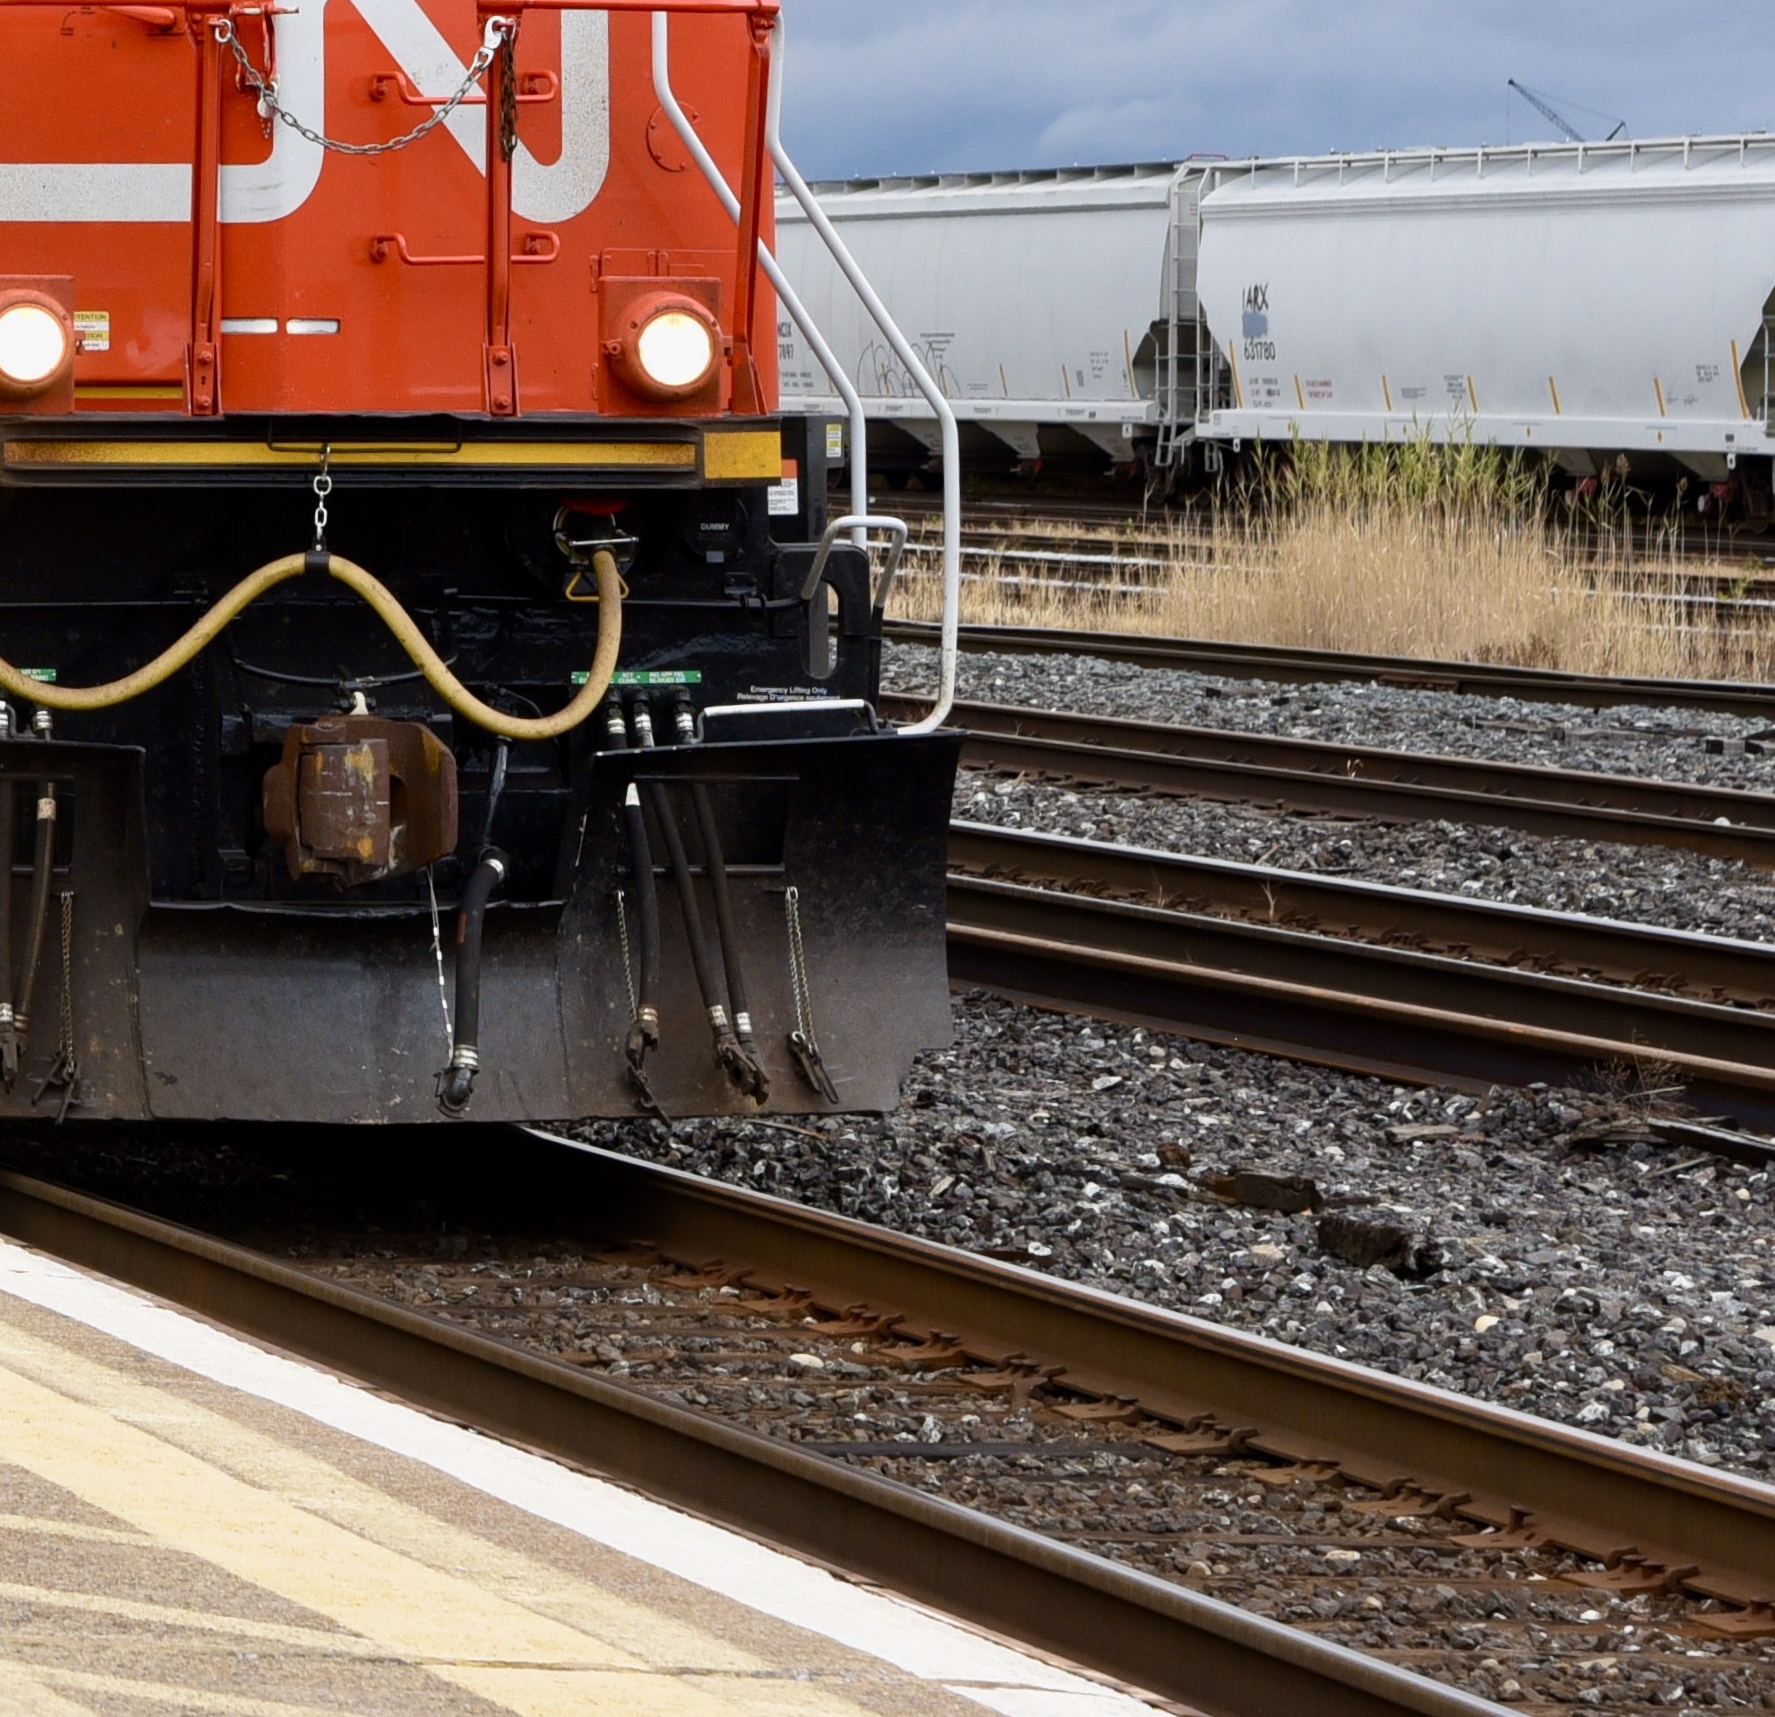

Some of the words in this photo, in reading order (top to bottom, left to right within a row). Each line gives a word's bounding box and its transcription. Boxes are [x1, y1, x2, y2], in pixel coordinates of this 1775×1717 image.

[1242, 283, 1269, 312] IARX
[1243, 341, 1276, 360] 631780
[751, 686, 788, 695] Emergency
[789, 686, 810, 696] Lifting
[811, 687, 828, 696] Only
